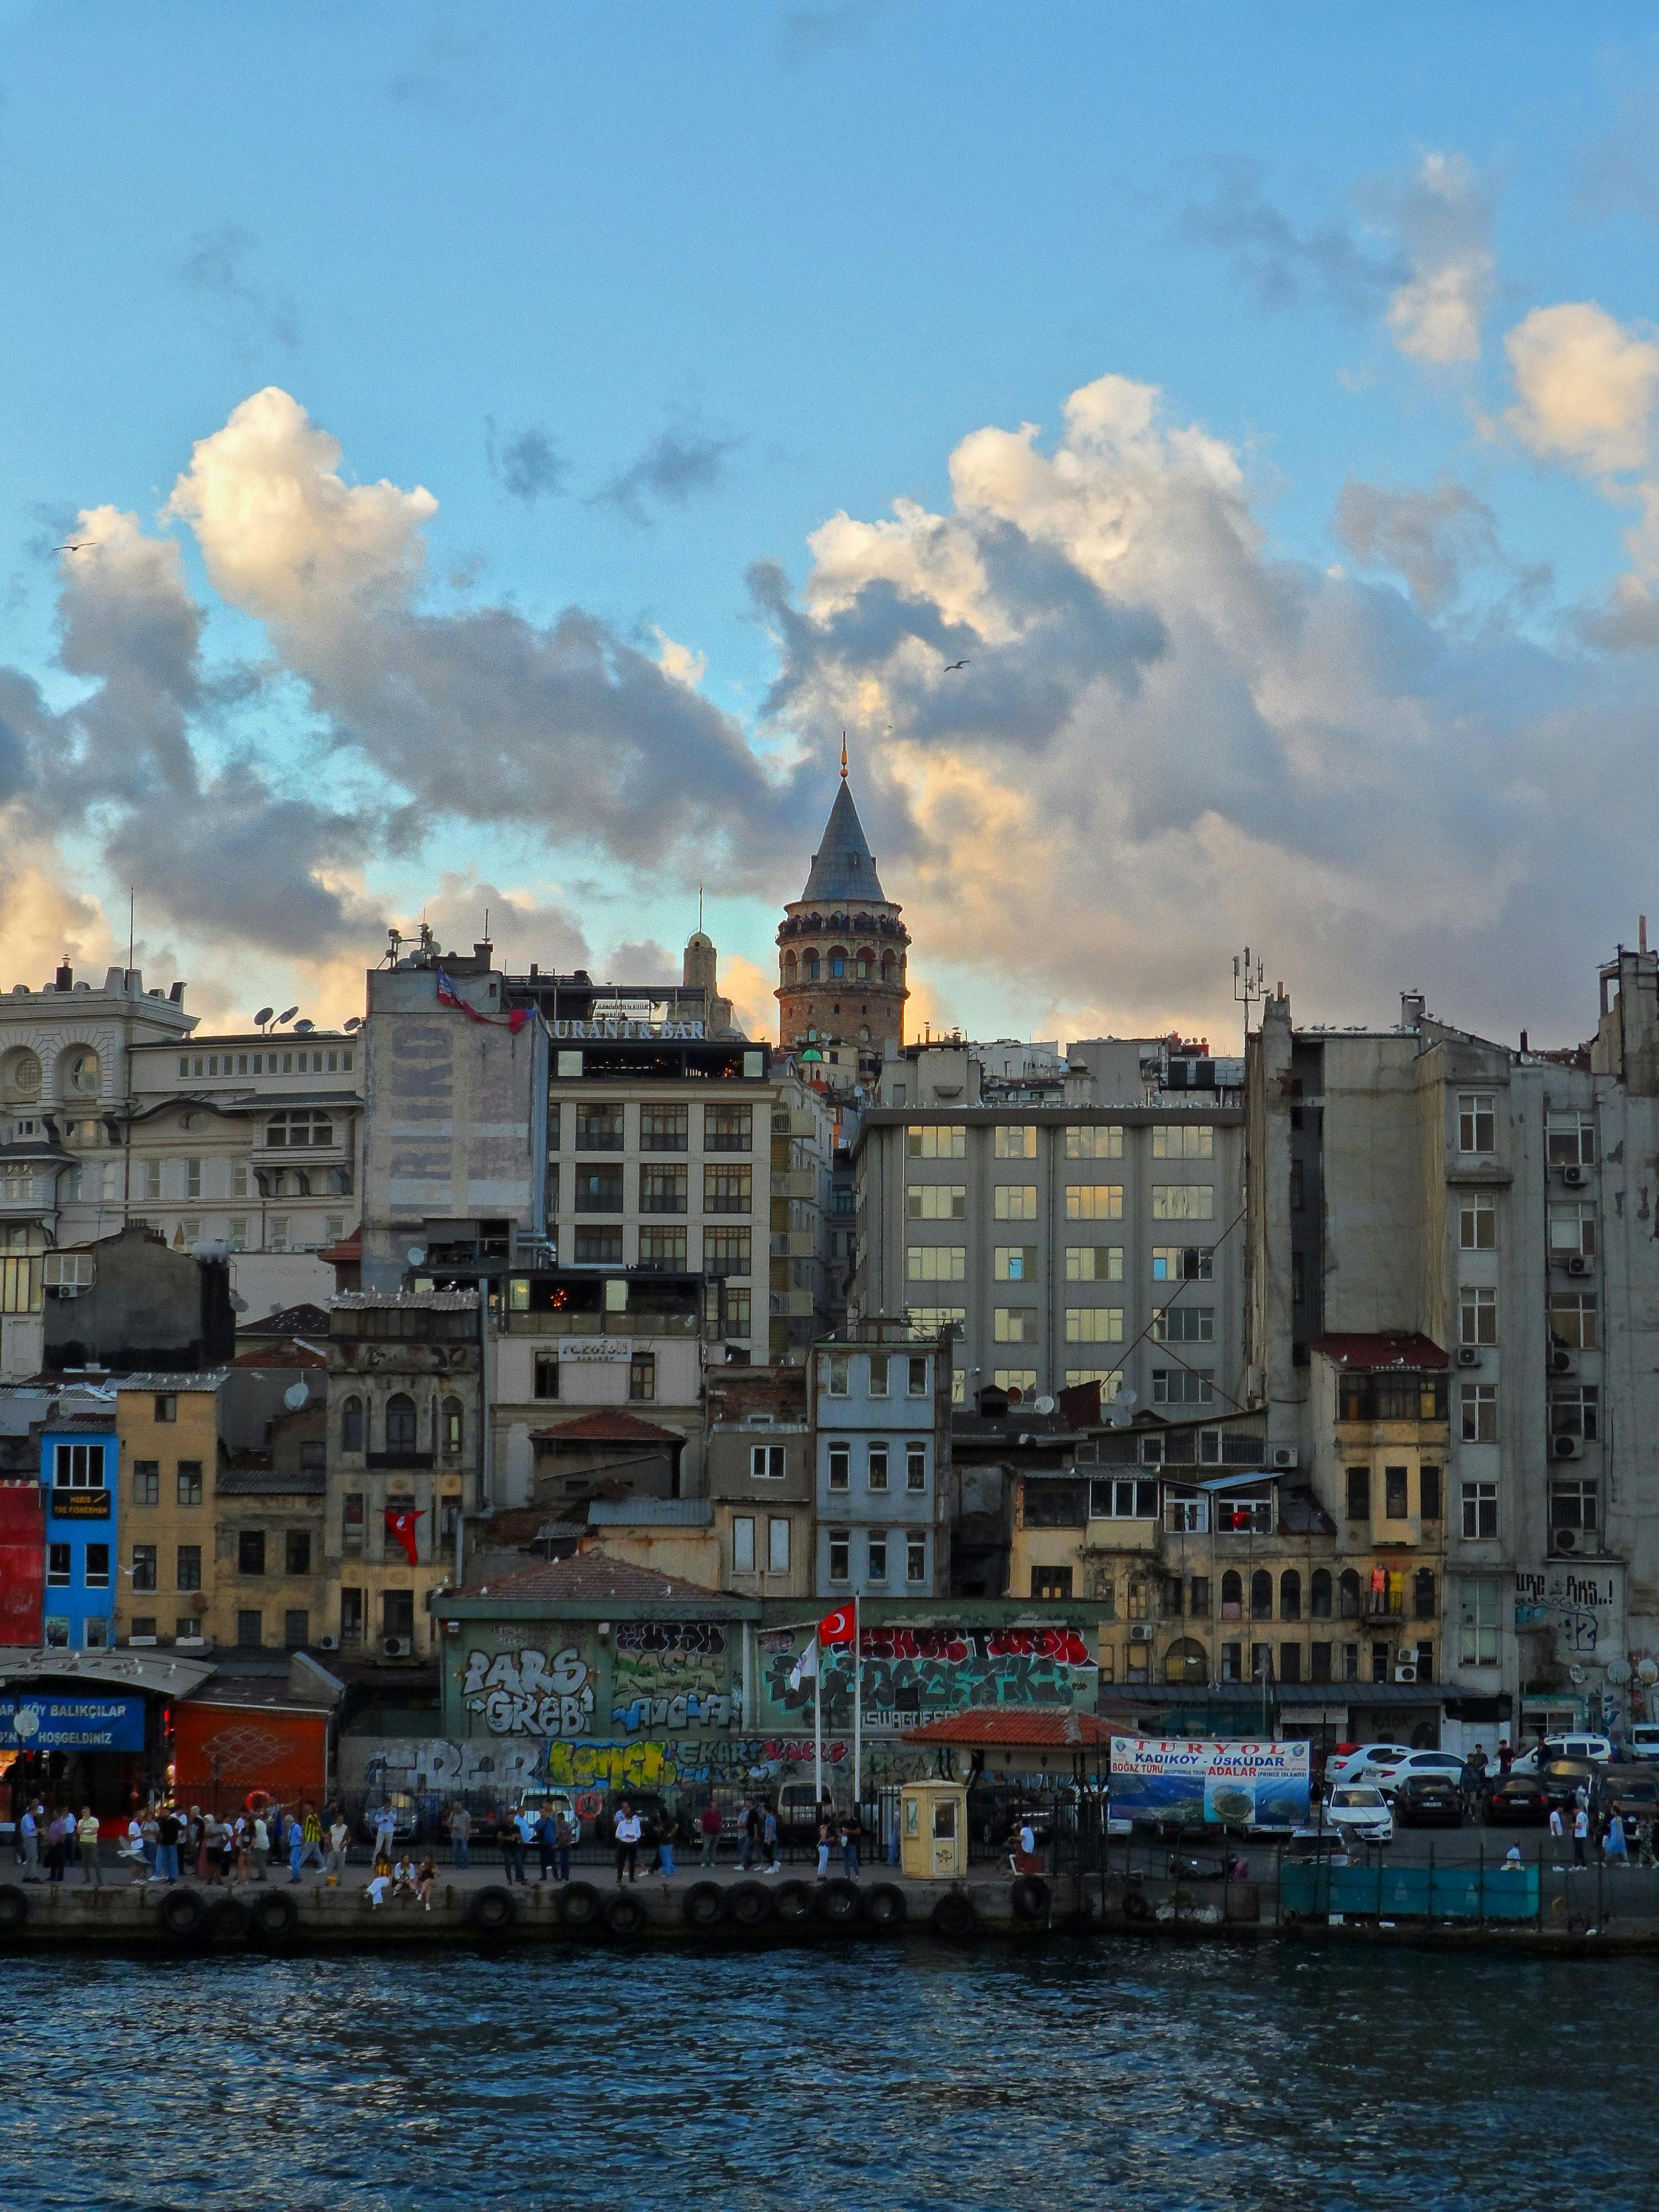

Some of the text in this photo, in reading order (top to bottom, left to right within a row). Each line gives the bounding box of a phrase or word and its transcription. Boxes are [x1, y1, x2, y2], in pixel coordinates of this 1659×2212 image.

[639, 1022, 654, 1039] &
[660, 1020, 705, 1039] BAR
[462, 1647, 587, 1696] PARS
[1134, 1740, 1286, 1755] TURYOL
[1135, 1753, 1200, 1764] KADIKÖY
[1213, 1754, 1285, 1767] ÜSKÜDAR
[1113, 1762, 1139, 1773] BOĞAZ
[1142, 1764, 1164, 1774] TURU
[1208, 1767, 1257, 1777] ADALAR
